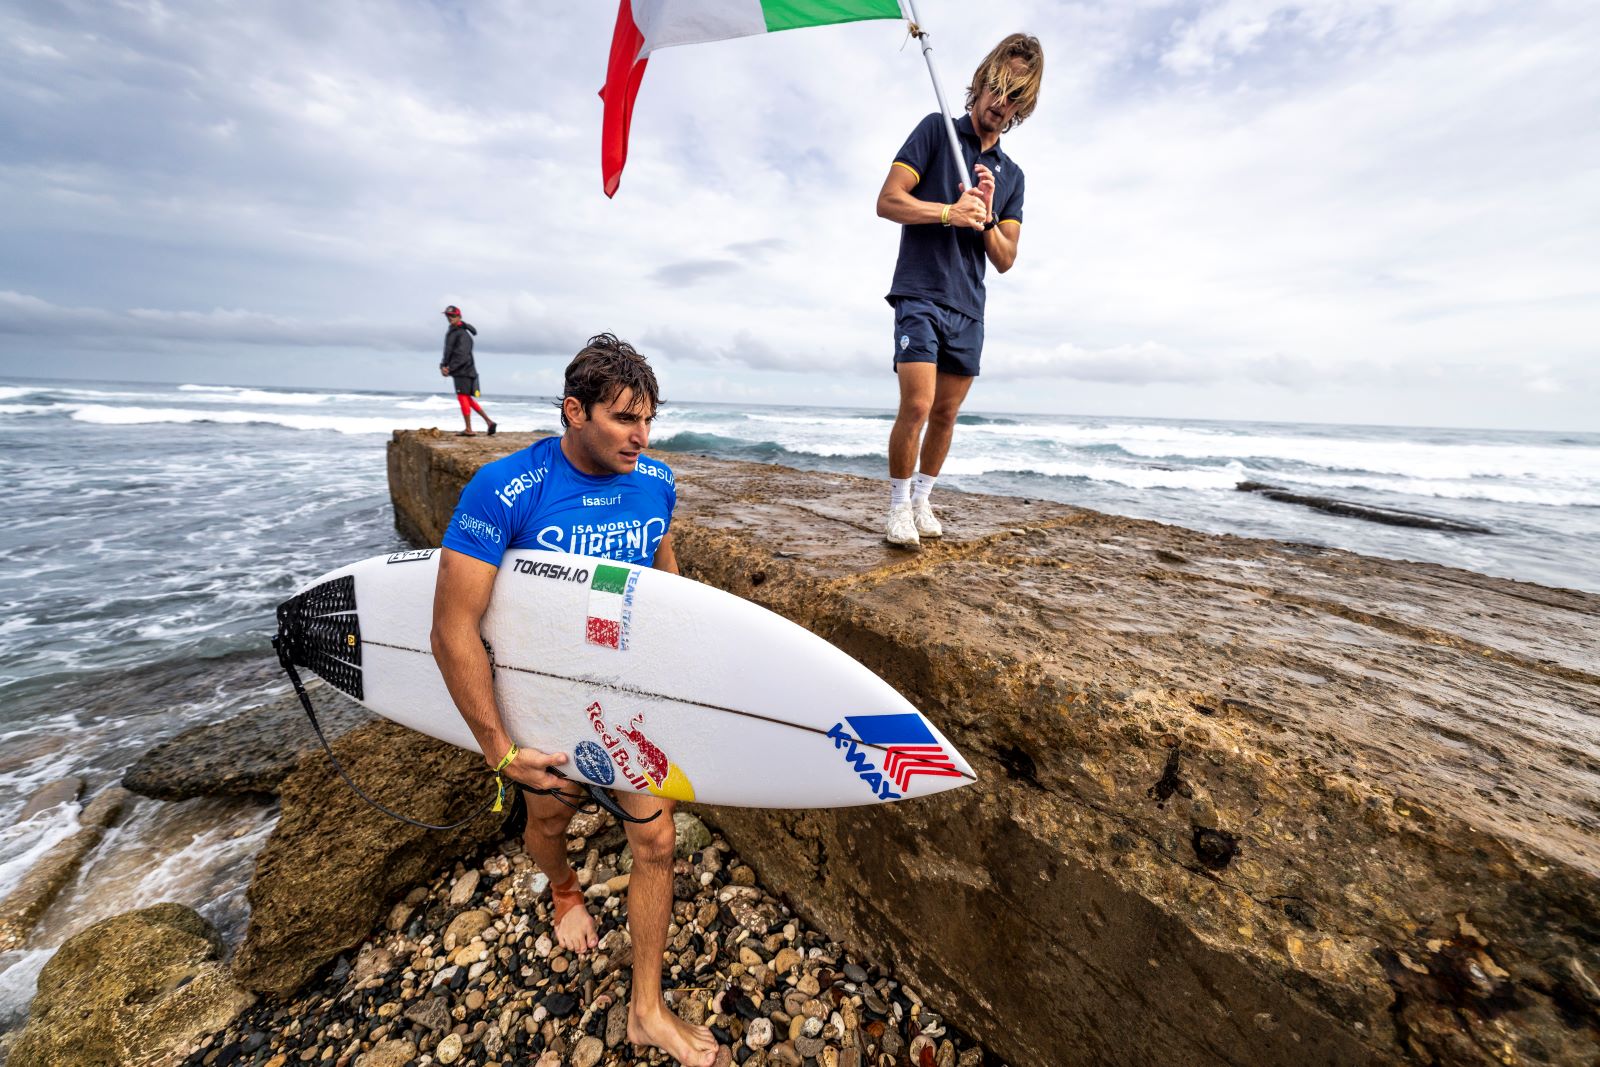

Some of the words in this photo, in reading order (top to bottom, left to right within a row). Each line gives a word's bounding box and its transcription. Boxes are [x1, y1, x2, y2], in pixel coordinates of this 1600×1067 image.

[582, 494, 622, 506] isasurf
[572, 525, 594, 534] ISA
[597, 520, 641, 532] WORLD
[513, 558, 589, 584] TOKASH.IO
[624, 569, 642, 607] TEAM
[585, 701, 621, 749] Red
[611, 747, 650, 790] Bull
